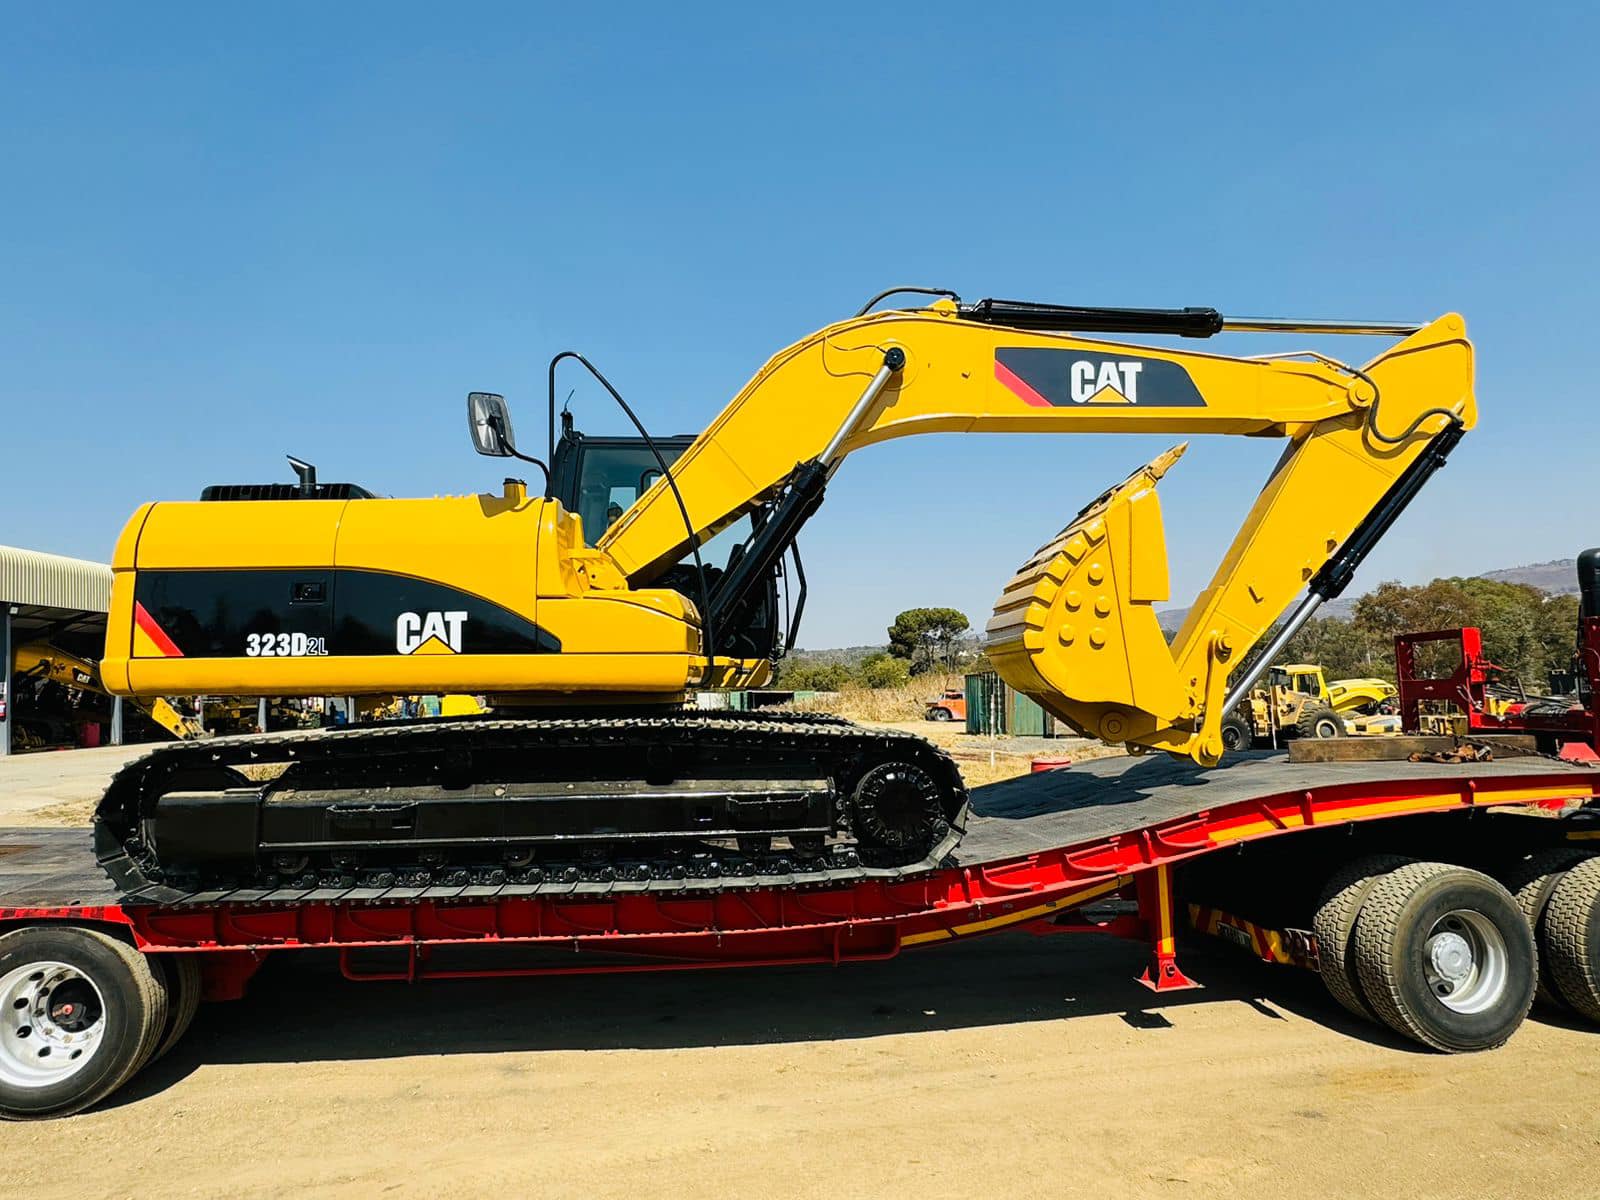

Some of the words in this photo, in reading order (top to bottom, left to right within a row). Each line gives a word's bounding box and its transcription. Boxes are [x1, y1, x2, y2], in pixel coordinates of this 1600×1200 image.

[1071, 360, 1142, 403] CAT
[396, 611, 468, 655] CAT
[76, 673, 91, 684] CAT
